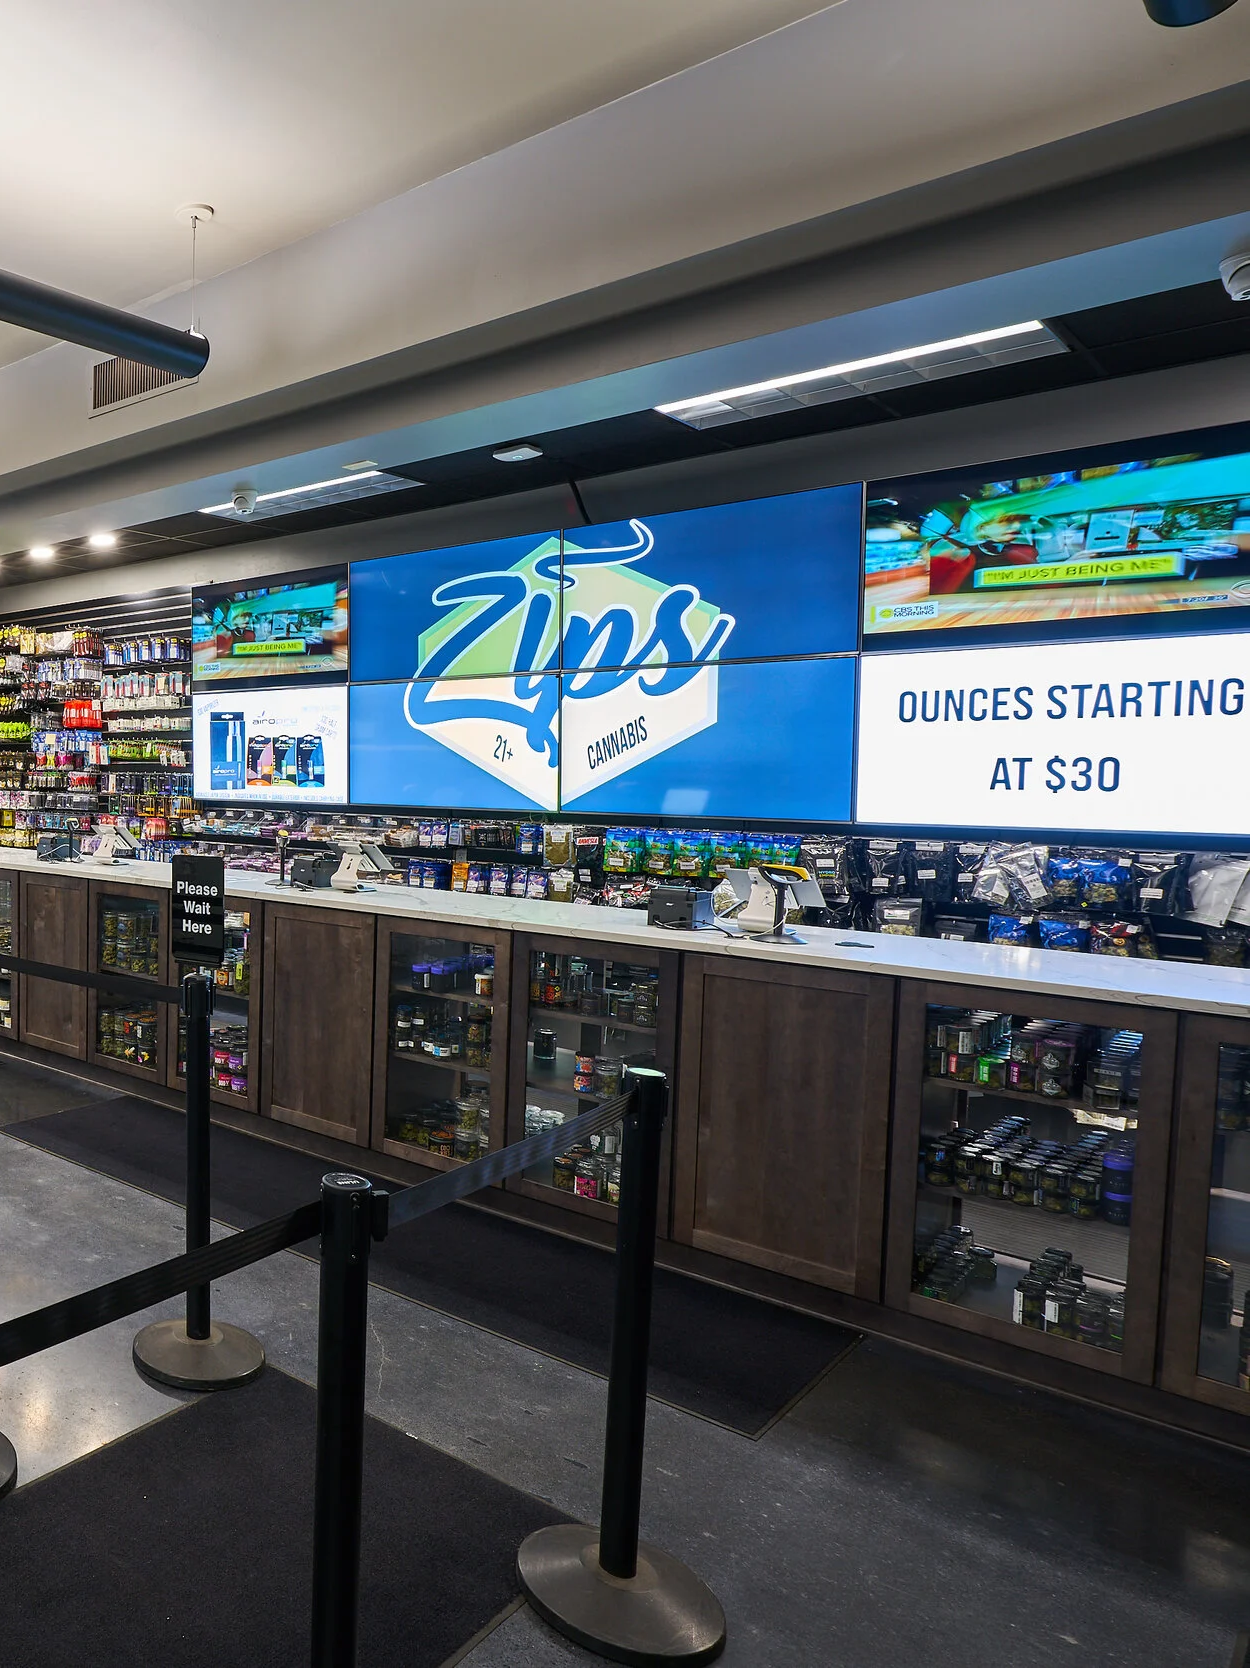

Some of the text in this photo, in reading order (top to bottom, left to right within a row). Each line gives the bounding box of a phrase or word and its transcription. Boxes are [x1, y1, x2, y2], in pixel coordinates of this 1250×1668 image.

[1018, 567, 1058, 579] JUST
[1066, 562, 1124, 576] BEING
[893, 610, 935, 618] MORNING
[403, 518, 736, 768] Zips
[898, 677, 1245, 723] OUNCES STARTING
[493, 734, 514, 762] 21+
[588, 716, 648, 770] CANNABIS
[990, 755, 1121, 794] AT $30
[176, 880, 218, 897] Please
[183, 900, 211, 915] Wait
[182, 918, 212, 935] Here
